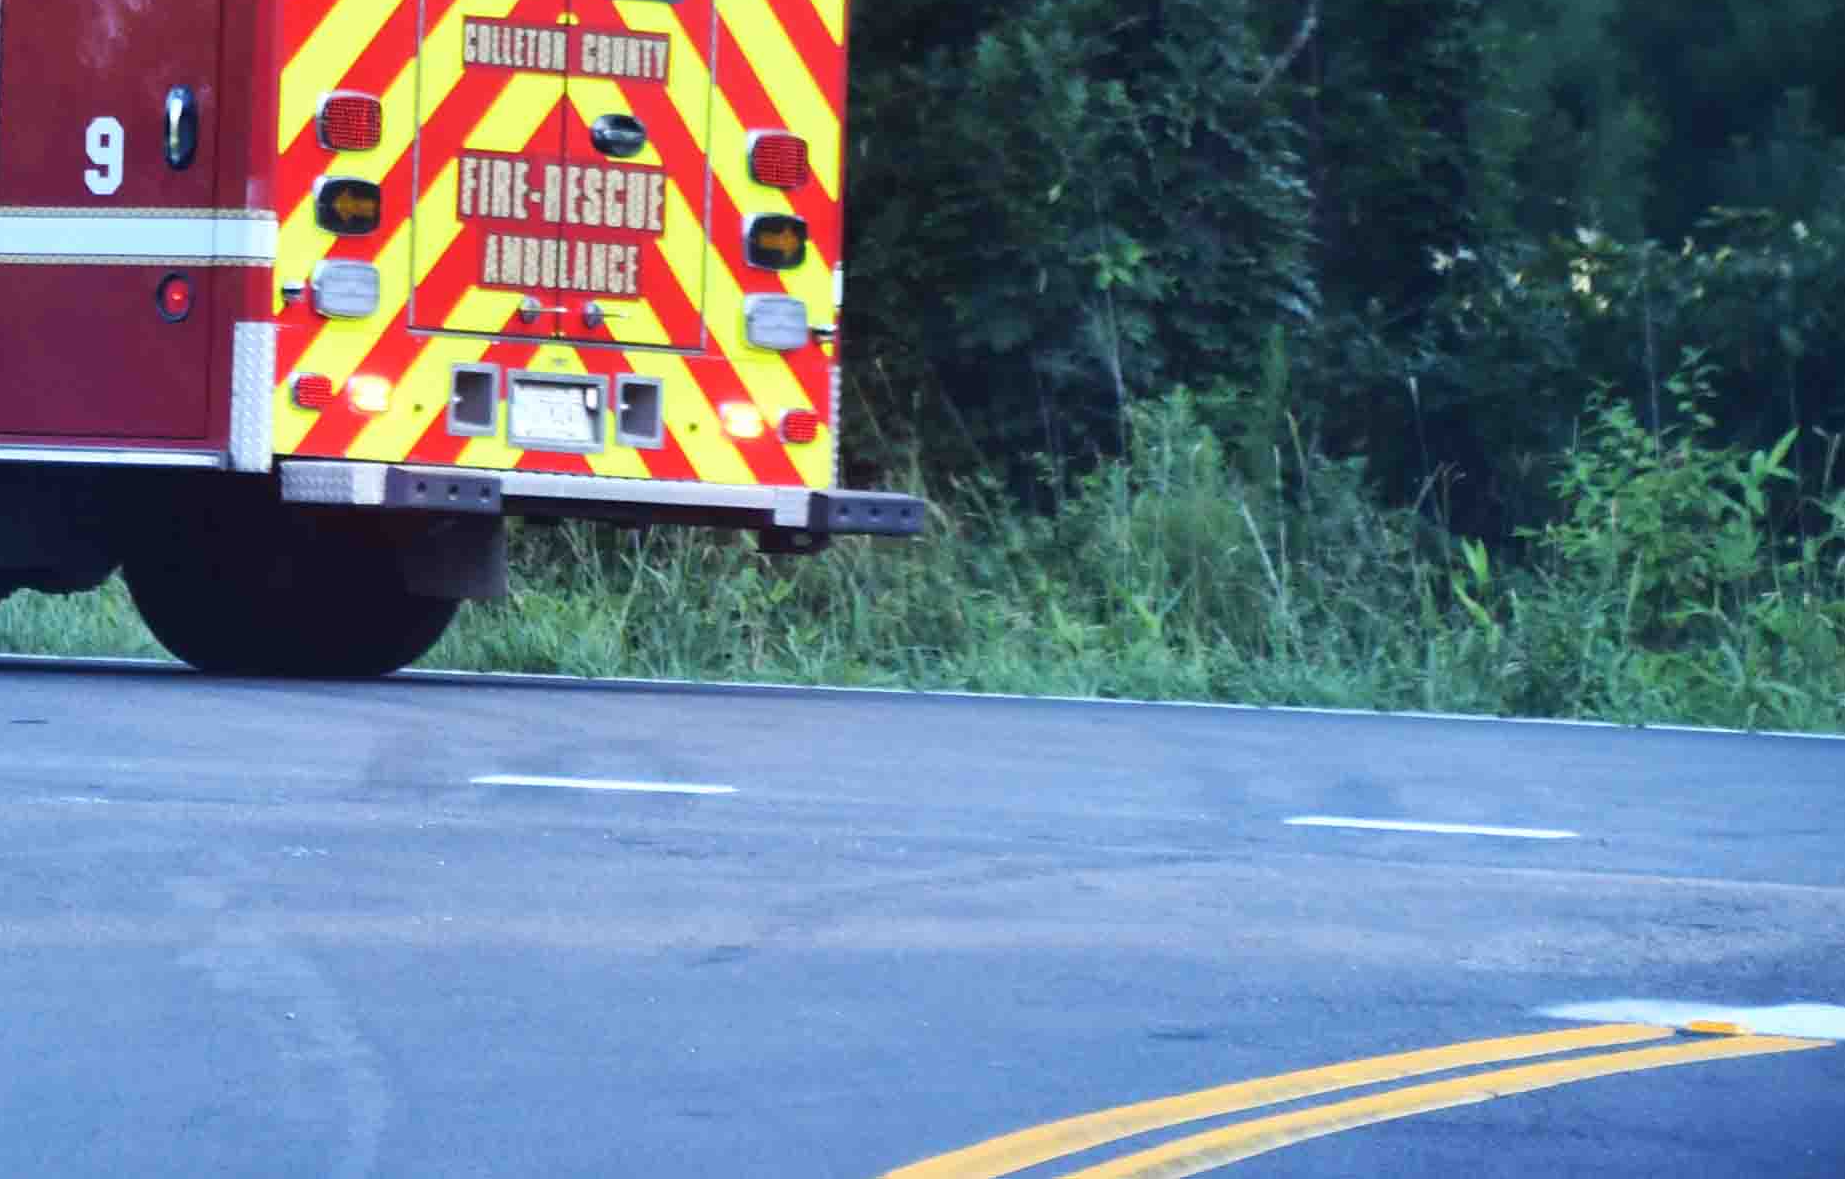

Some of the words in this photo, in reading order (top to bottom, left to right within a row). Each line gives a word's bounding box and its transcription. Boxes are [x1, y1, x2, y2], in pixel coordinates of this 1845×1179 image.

[464, 23, 567, 72] COLLETON
[581, 32, 669, 80] COUNTY
[84, 116, 124, 195] 9
[461, 156, 664, 231] FIRE-RESCUE
[484, 234, 639, 295] AMBULANCE
